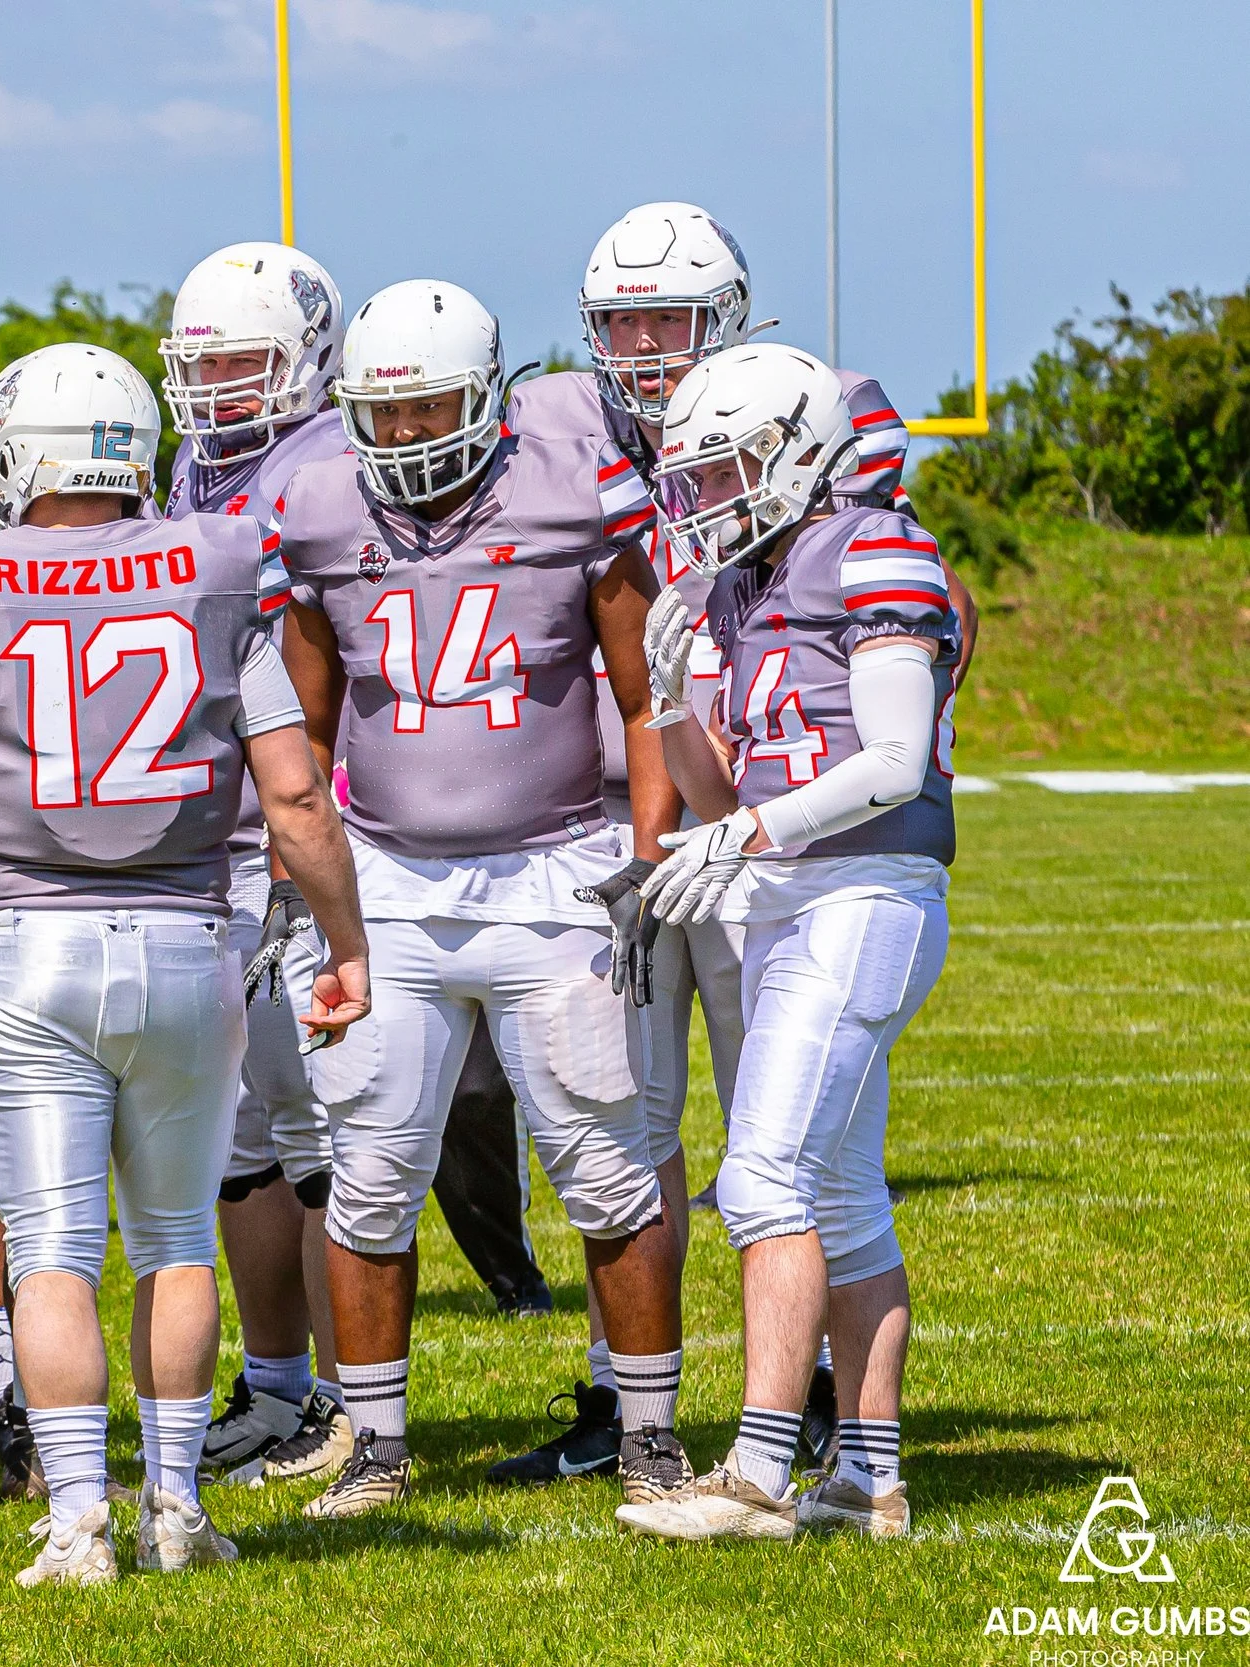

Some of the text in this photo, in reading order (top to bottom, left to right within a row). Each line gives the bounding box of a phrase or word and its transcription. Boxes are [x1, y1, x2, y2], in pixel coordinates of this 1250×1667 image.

[616, 284, 658, 294] Riddell
[184, 325, 212, 336] Riddell
[375, 365, 410, 379] Riddell
[90, 420, 135, 461] 12
[71, 470, 133, 487] schutt
[363, 583, 532, 734] 14
